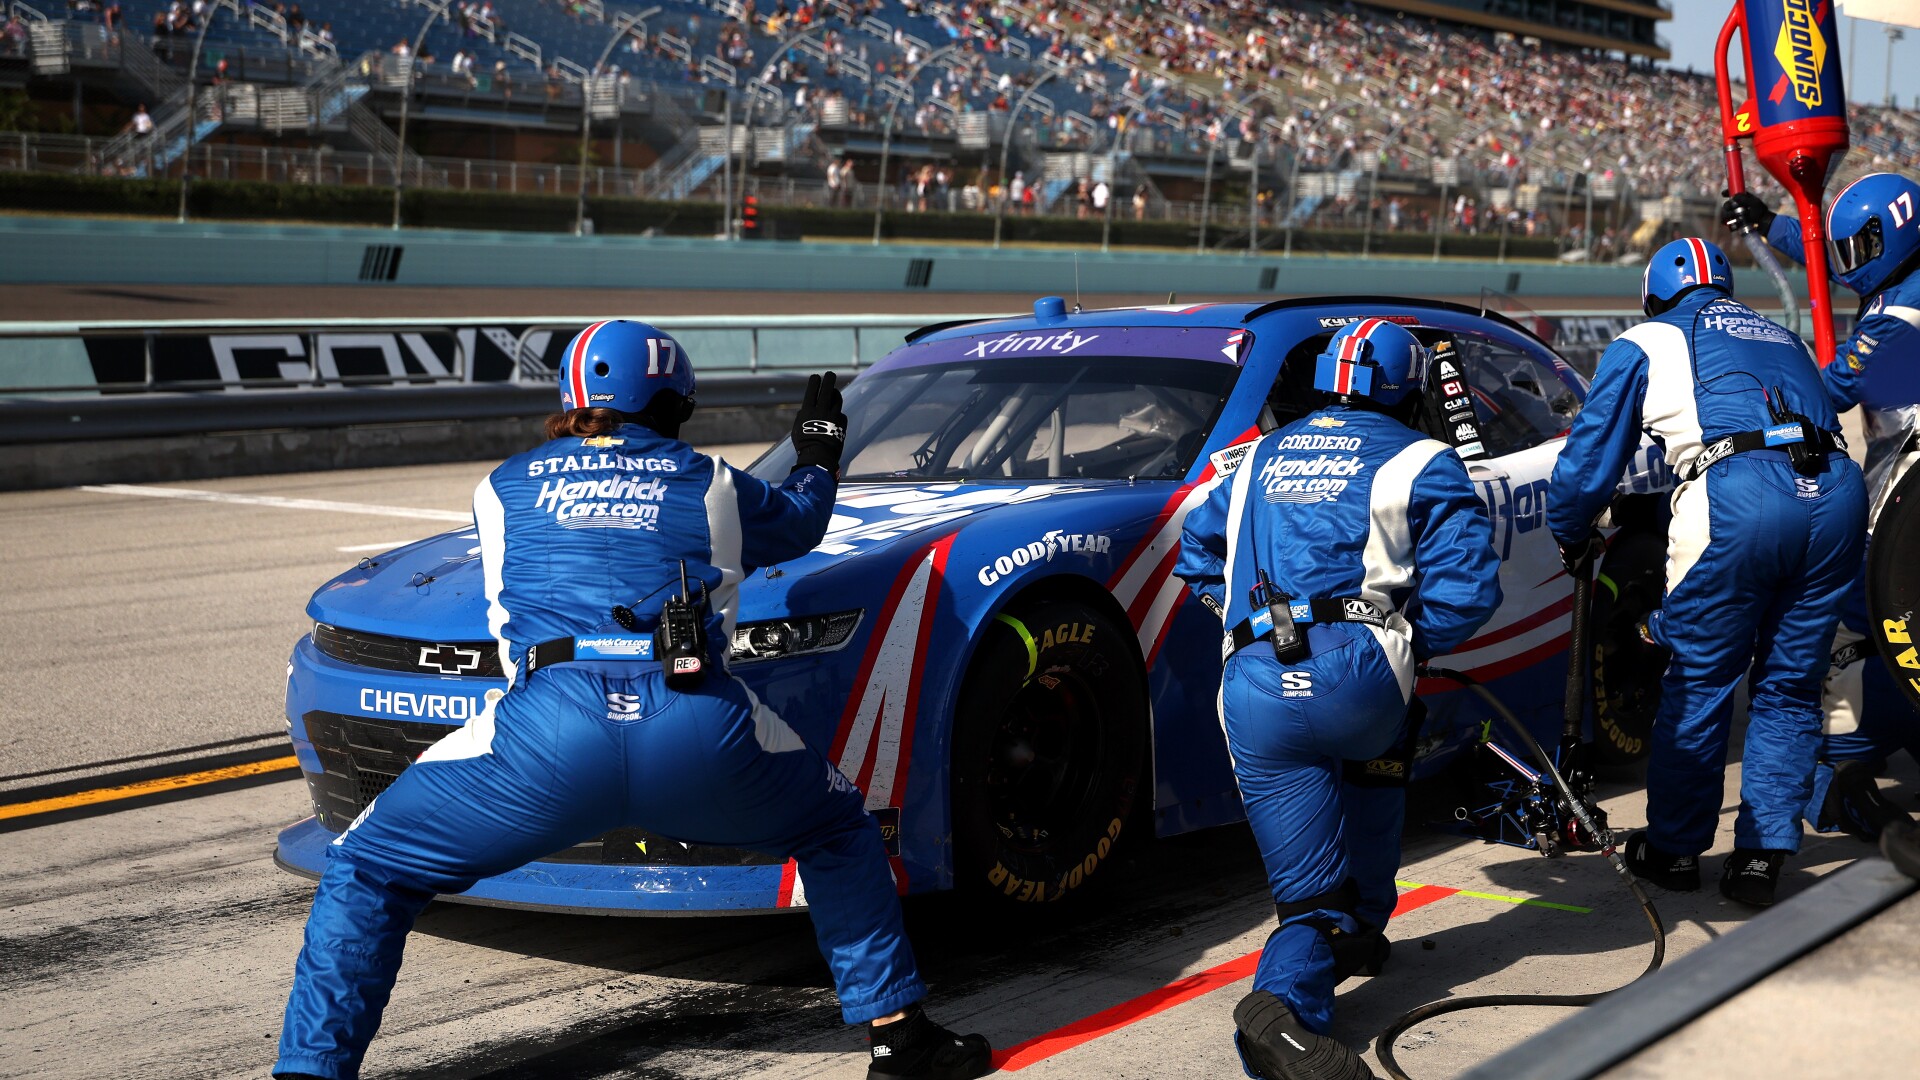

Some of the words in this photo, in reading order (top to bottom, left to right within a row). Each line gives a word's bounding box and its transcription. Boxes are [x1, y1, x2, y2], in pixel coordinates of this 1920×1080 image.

[1887, 191, 1914, 229] 17
[964, 331, 1100, 357] xfinity
[646, 338, 677, 377] 17
[1278, 434, 1362, 451] CORDERO
[1455, 423, 1477, 438] MAC
[1457, 433, 1478, 442] TOOLS
[528, 453, 678, 477] STALLINGS
[1258, 454, 1365, 486] Hendrick
[534, 474, 668, 513] Hendrick
[1265, 478, 1348, 494] Cars.com
[556, 500, 660, 521] Cars.com
[1034, 622, 1097, 653] AGLE
[360, 688, 478, 720] CHEVROL
[607, 712, 640, 721] SIMPSON
